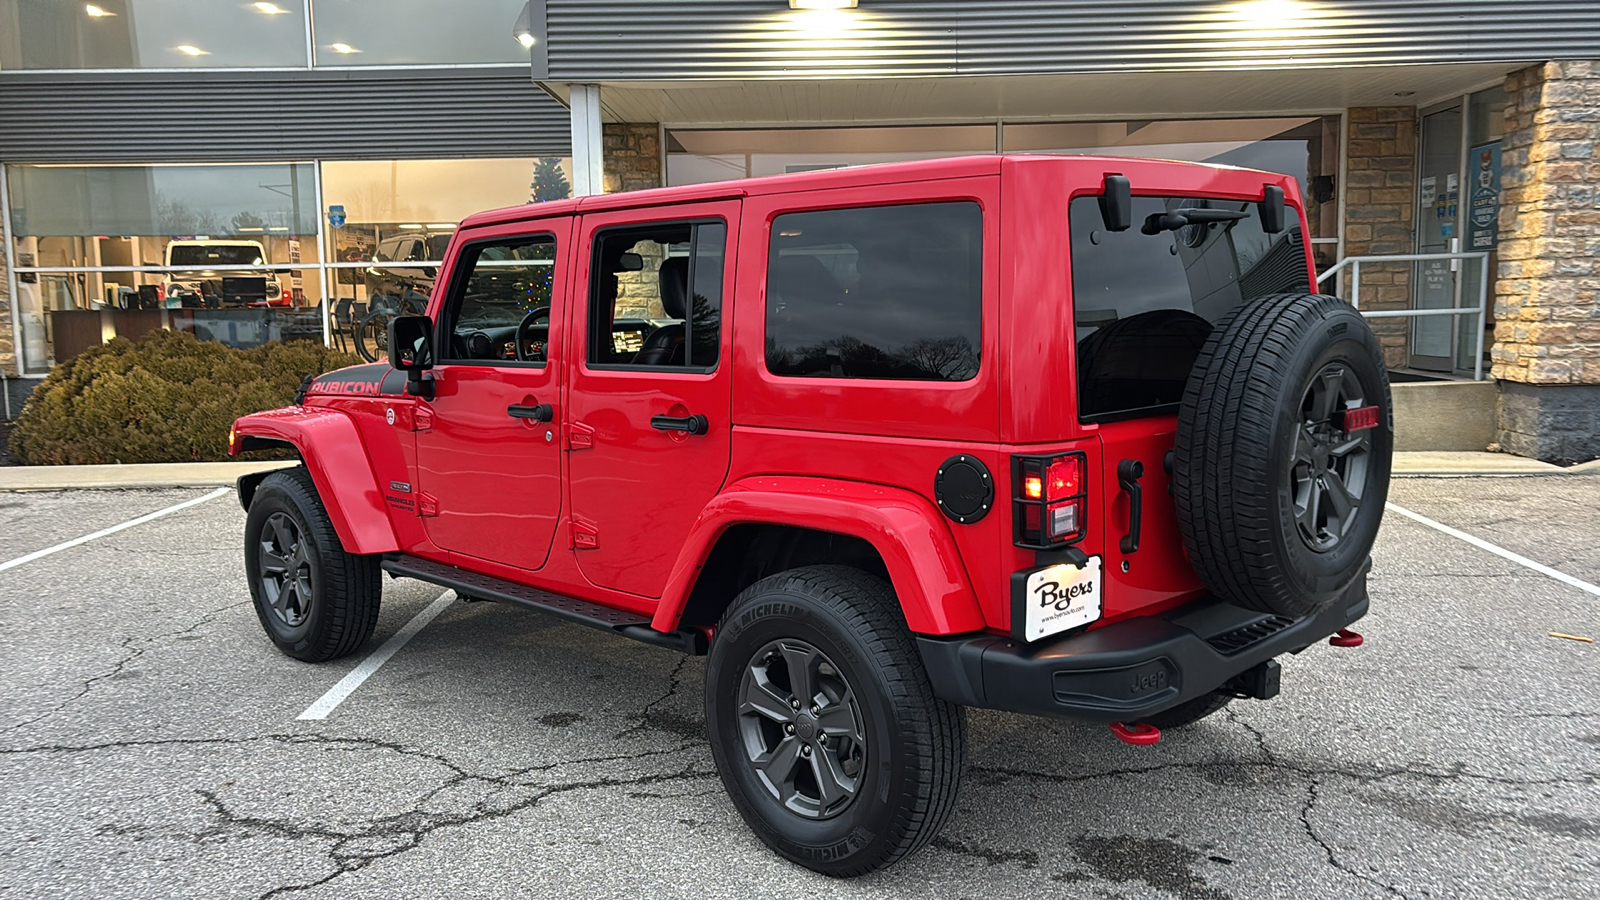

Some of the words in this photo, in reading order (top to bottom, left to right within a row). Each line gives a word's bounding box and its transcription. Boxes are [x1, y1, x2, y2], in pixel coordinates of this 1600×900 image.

[310, 381, 380, 396] RUBICON
[1033, 580, 1093, 611] Byers
[741, 602, 806, 626] MICHELIN
[1041, 605, 1085, 623] www.byersauto.com
[1129, 670, 1167, 694] Jeep
